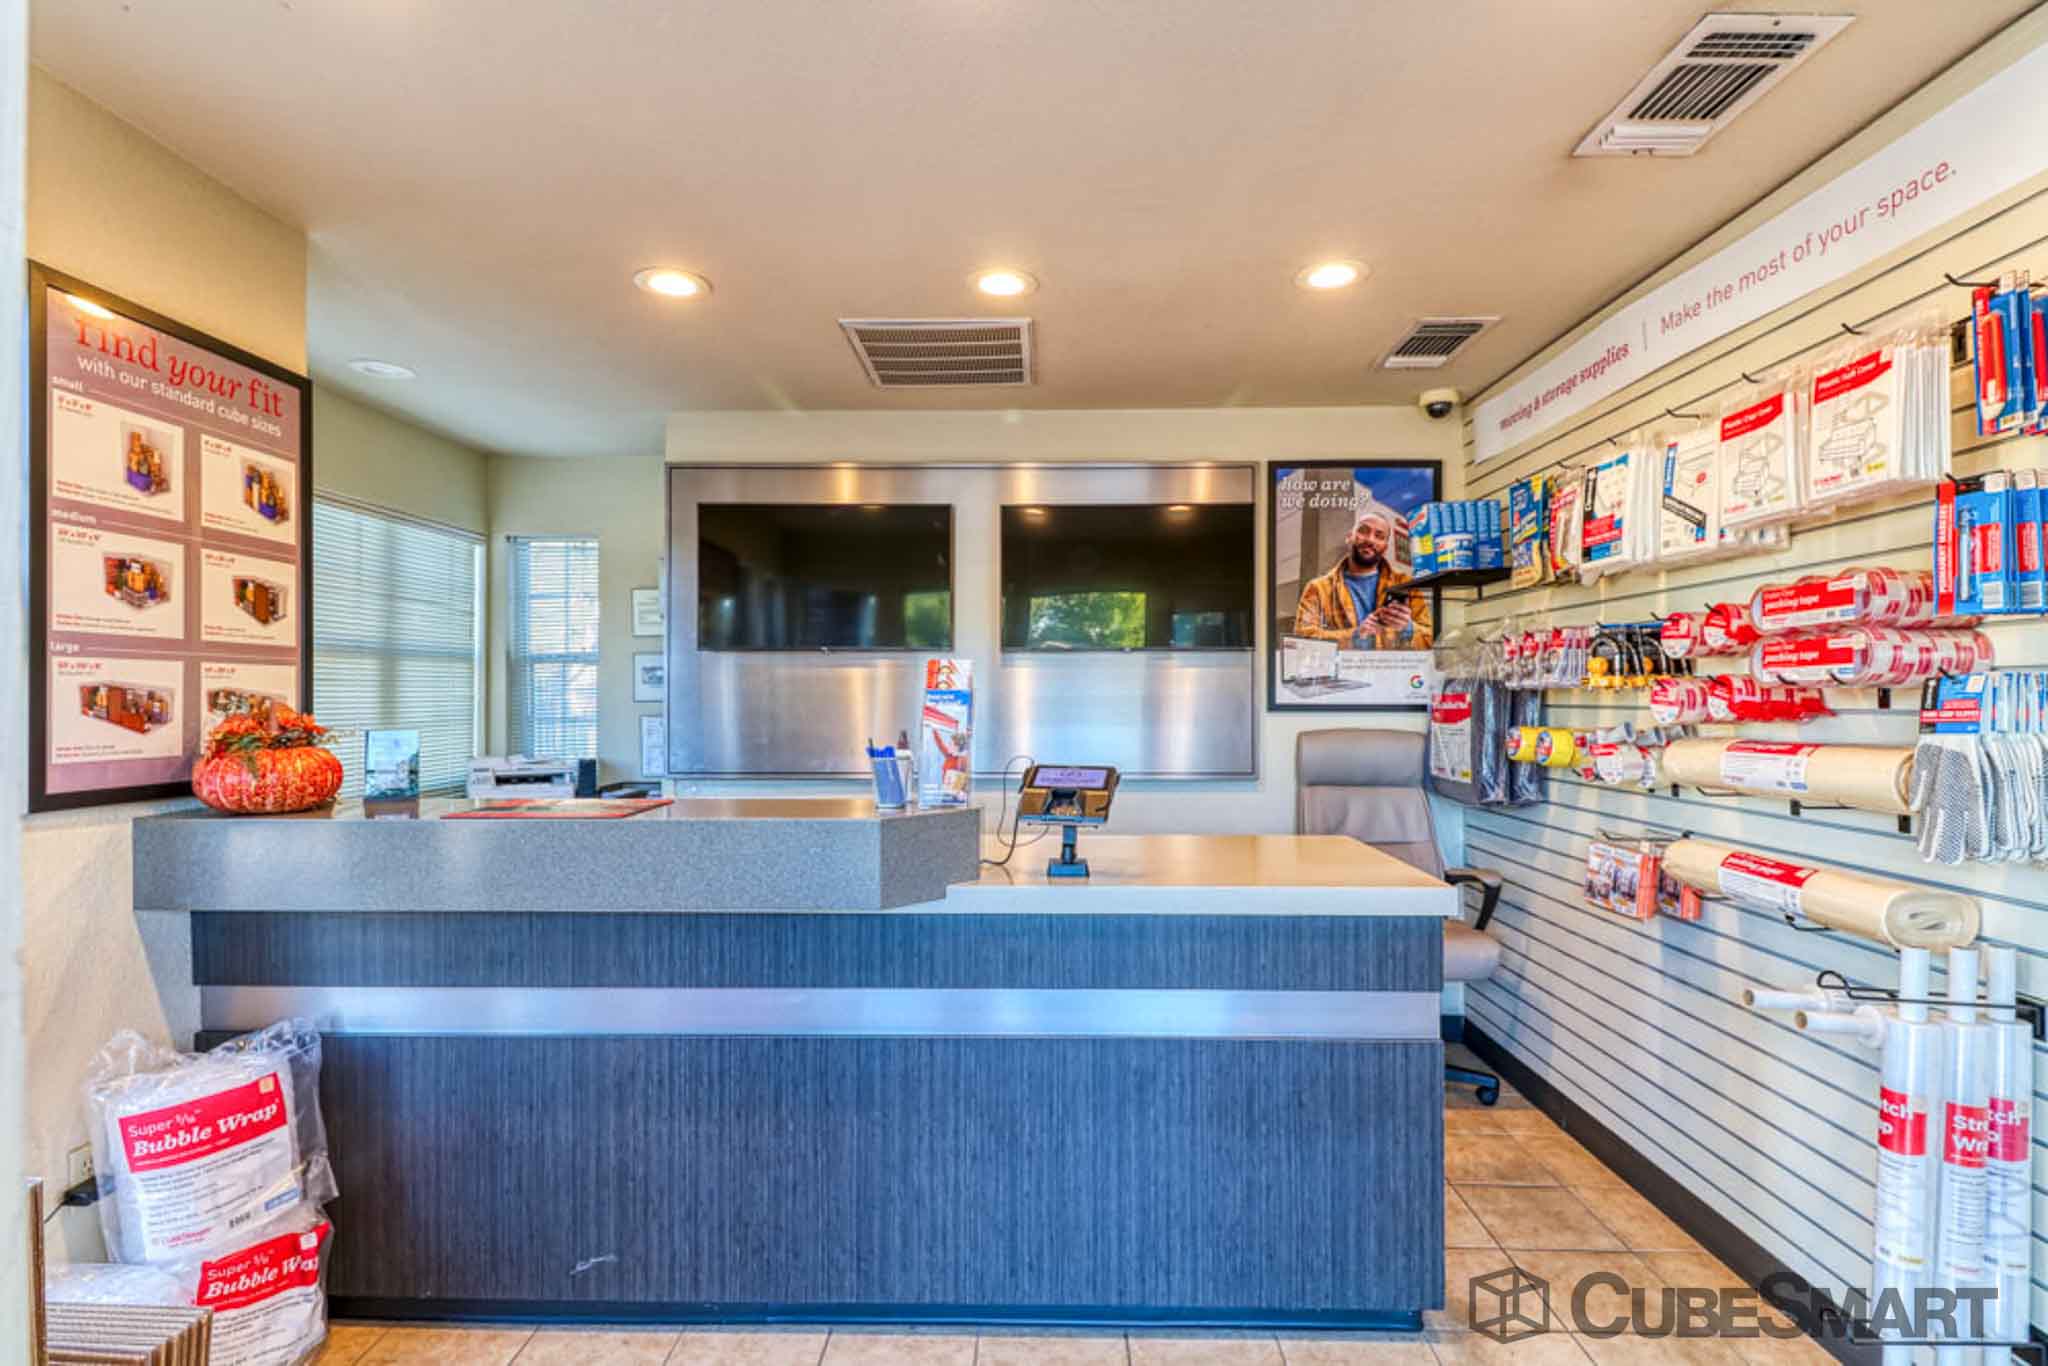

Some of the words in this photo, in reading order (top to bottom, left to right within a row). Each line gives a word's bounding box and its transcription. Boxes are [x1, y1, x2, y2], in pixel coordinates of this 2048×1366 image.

[1660, 299, 1702, 336] Make
[1706, 282, 1734, 310] the
[1738, 249, 1788, 294] most
[1792, 232, 1815, 263] of
[1817, 206, 1871, 257] your
[1876, 160, 1957, 217] space.
[1579, 343, 1630, 382] supplies
[77, 355, 116, 380] with
[118, 369, 149, 390] our
[151, 381, 217, 415] standard
[216, 404, 250, 426] cube
[250, 416, 283, 438] sizes
[168, 355, 243, 401] your
[247, 376, 285, 418] fit
[1280, 495, 1306, 510] we
[1320, 479, 1352, 492] are
[127, 1120, 174, 1138] Super
[133, 1125, 212, 1158] Bubble
[216, 1101, 279, 1134] Wrap
[205, 1267, 279, 1298] Bubble
[207, 1261, 251, 1280] Super
